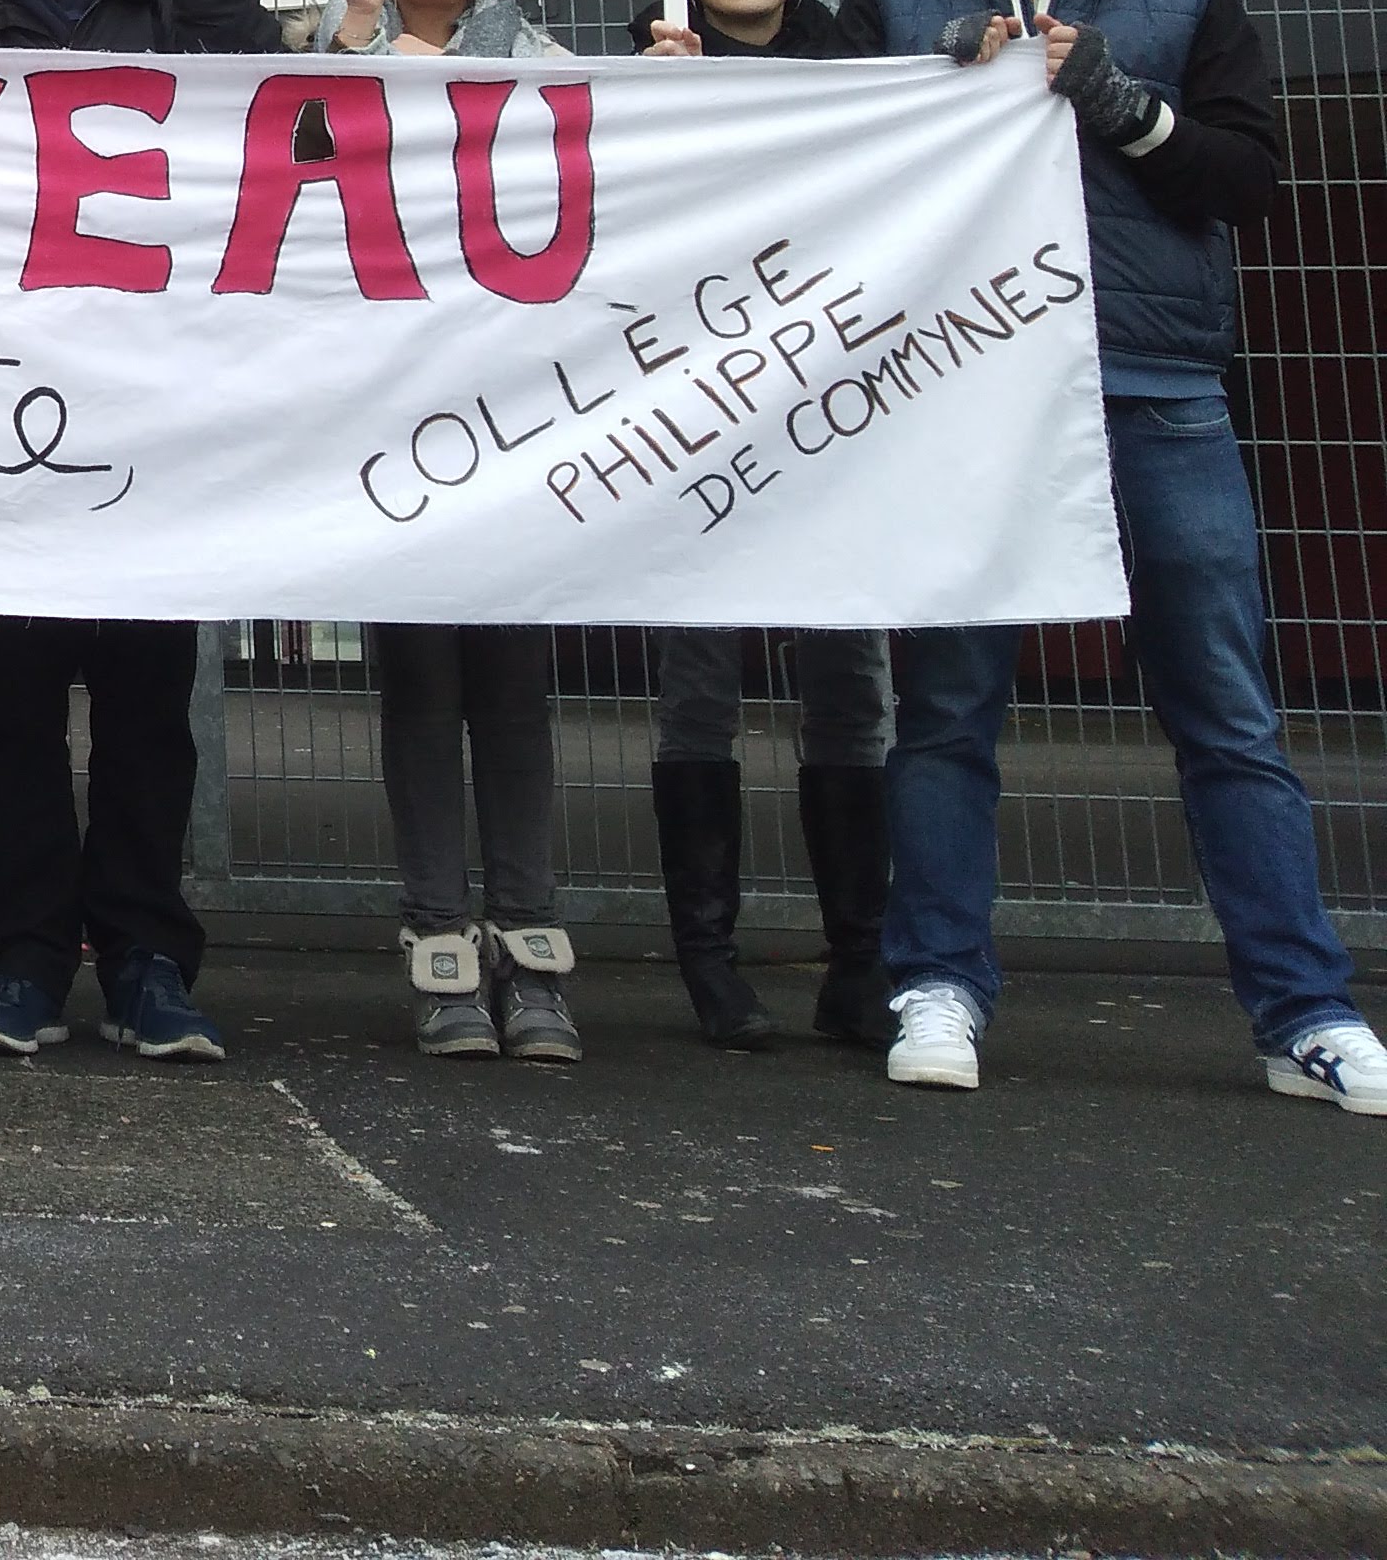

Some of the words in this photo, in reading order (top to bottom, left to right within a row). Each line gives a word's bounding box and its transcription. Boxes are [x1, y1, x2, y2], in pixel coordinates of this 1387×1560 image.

[358, 237, 834, 525] COLLÈGE
[785, 240, 1089, 458] COMMYNES
[677, 442, 783, 536] DE
